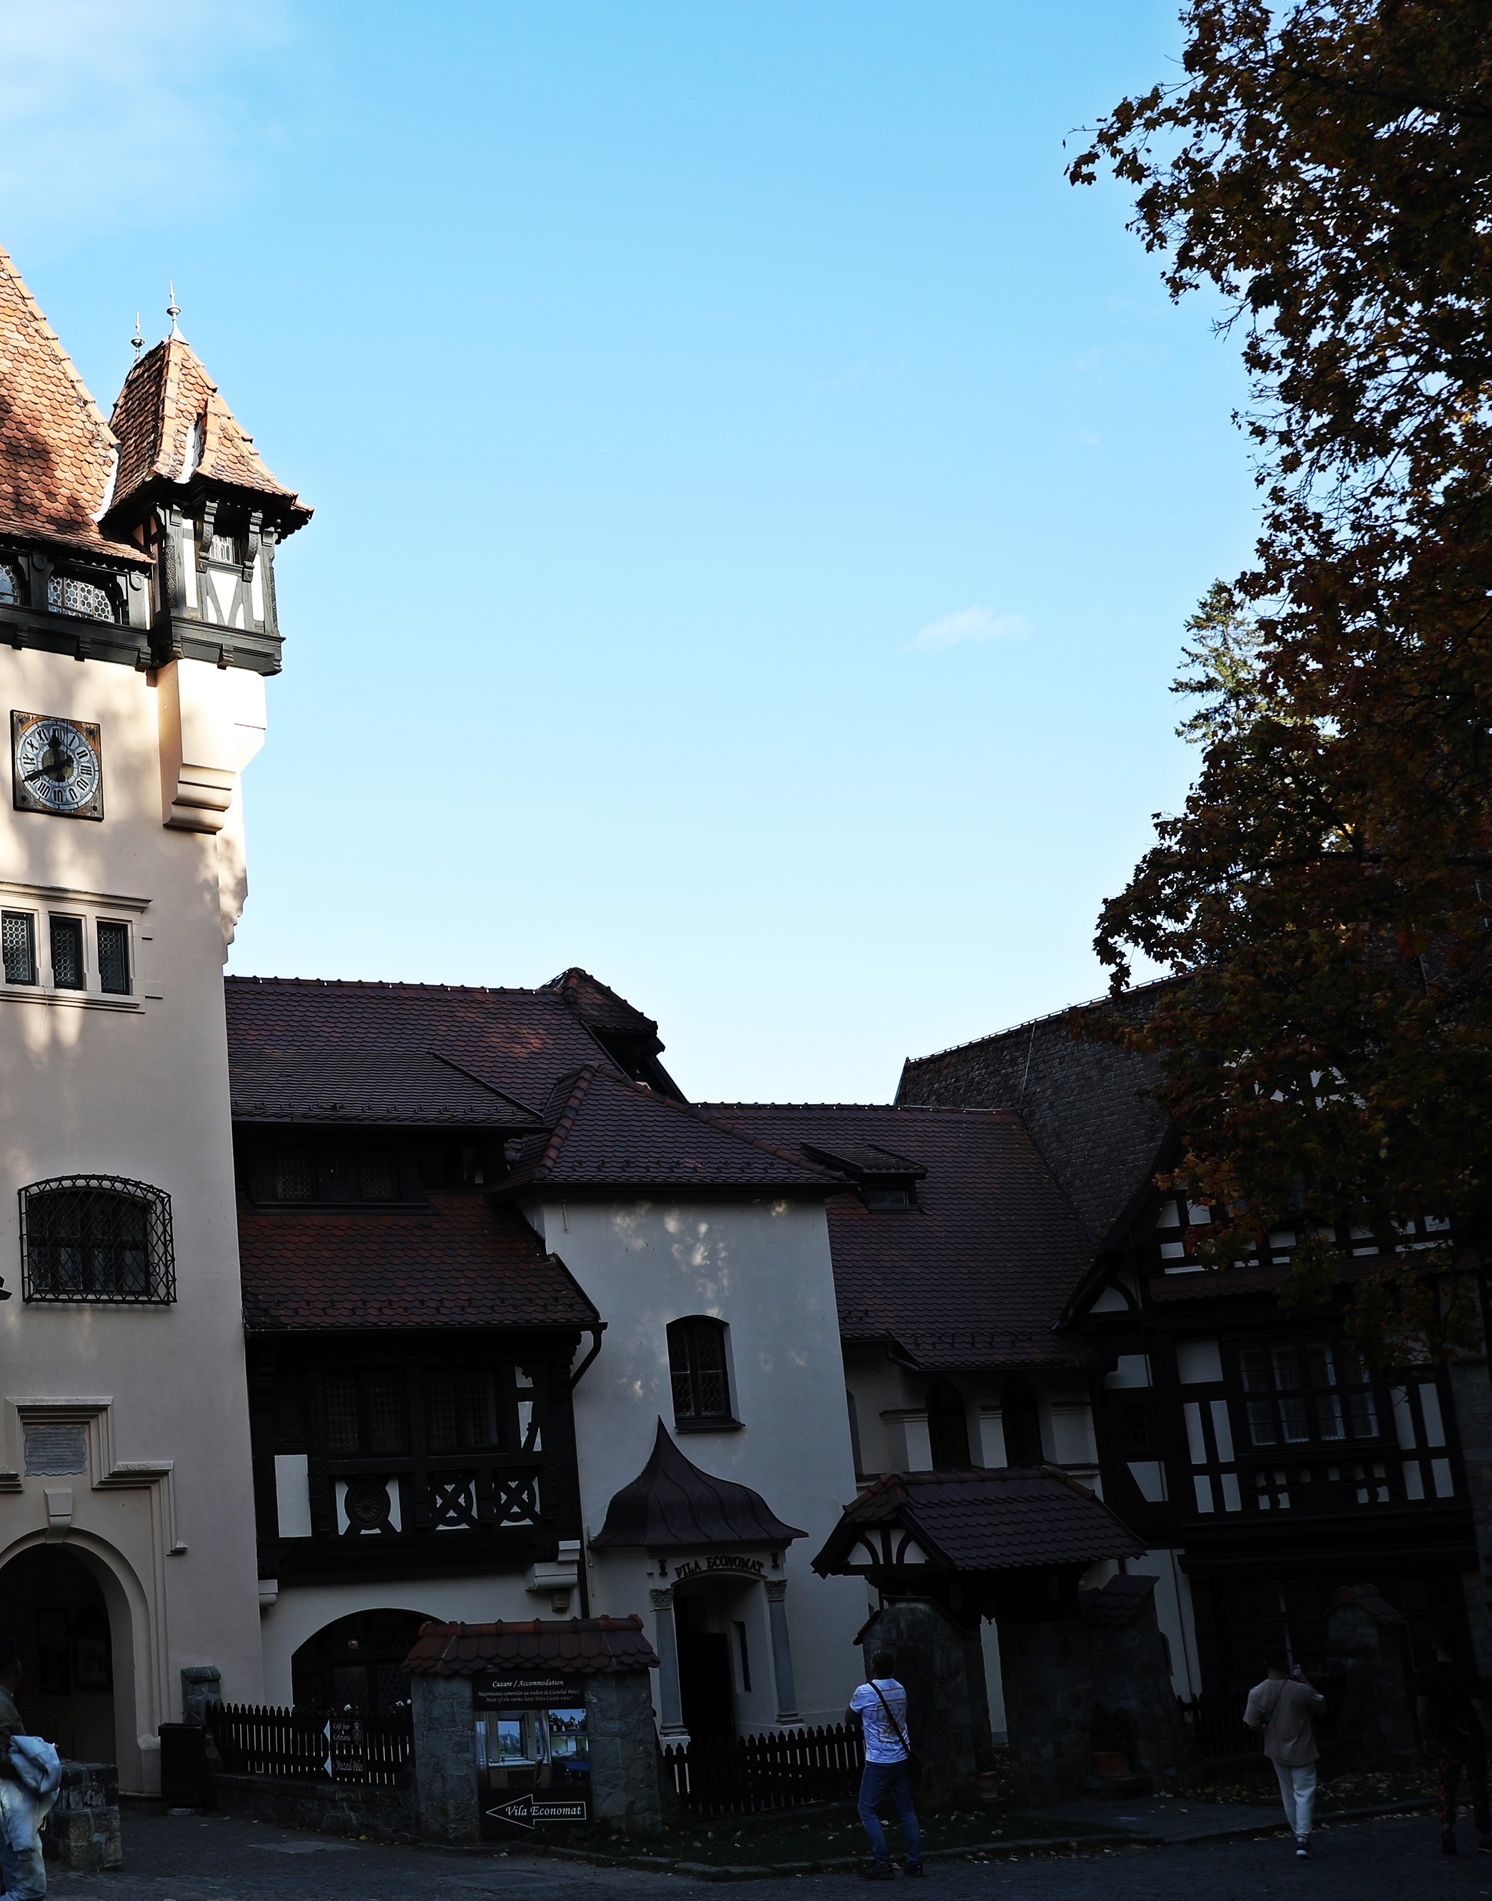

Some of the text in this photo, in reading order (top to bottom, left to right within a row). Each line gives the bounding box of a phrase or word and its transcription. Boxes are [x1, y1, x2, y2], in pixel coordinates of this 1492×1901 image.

[674, 1555, 764, 1578] VILA ECONOMAT
[492, 1680, 513, 1688] Cazare
[518, 1679, 564, 1688] Accommodation
[505, 1804, 582, 1816] Vila Economat
